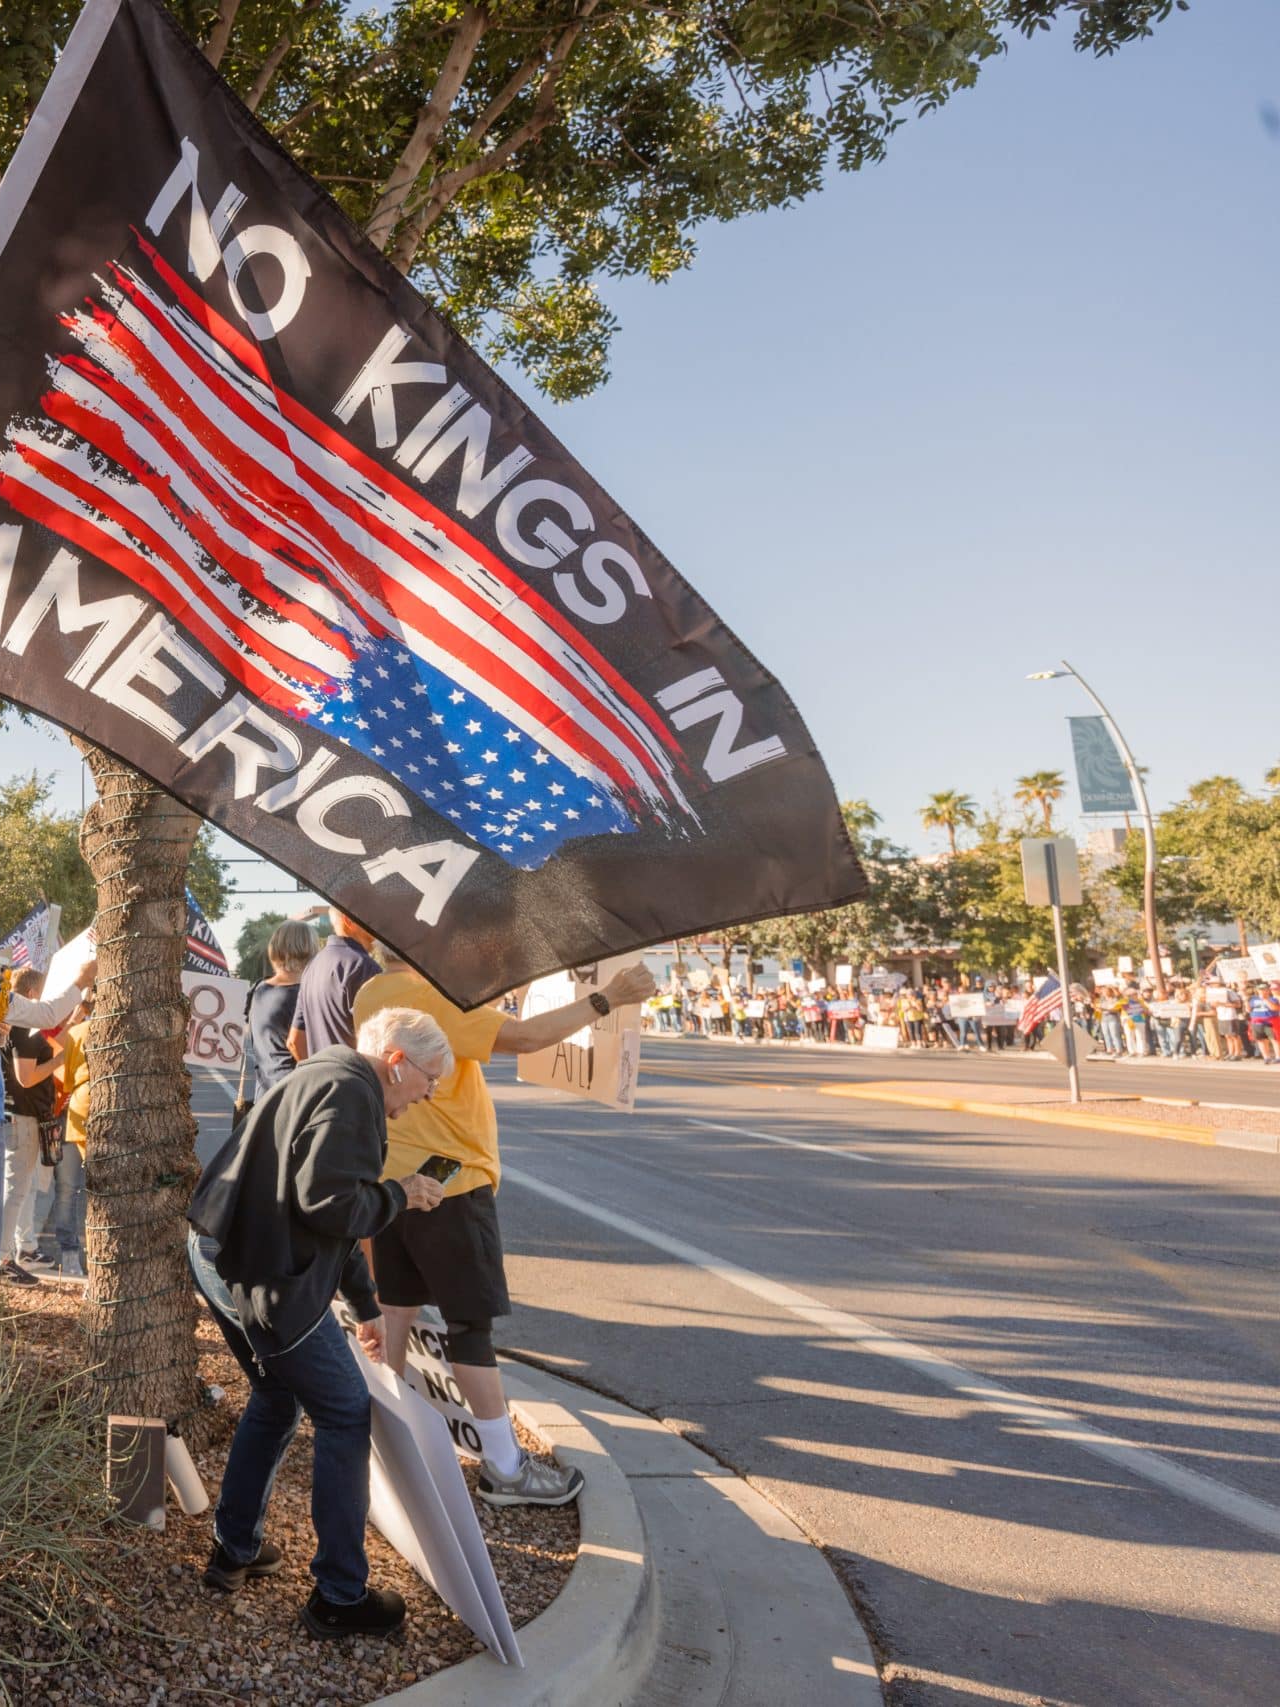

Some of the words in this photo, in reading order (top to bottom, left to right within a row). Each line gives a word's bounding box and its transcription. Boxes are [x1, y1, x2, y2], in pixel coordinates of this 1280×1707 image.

[145, 137, 312, 341] NO
[333, 327, 651, 625] KINGS
[656, 666, 787, 783] IN
[191, 917, 220, 949] KIN
[189, 984, 225, 1019] O
[421, 1368, 466, 1408] NO
